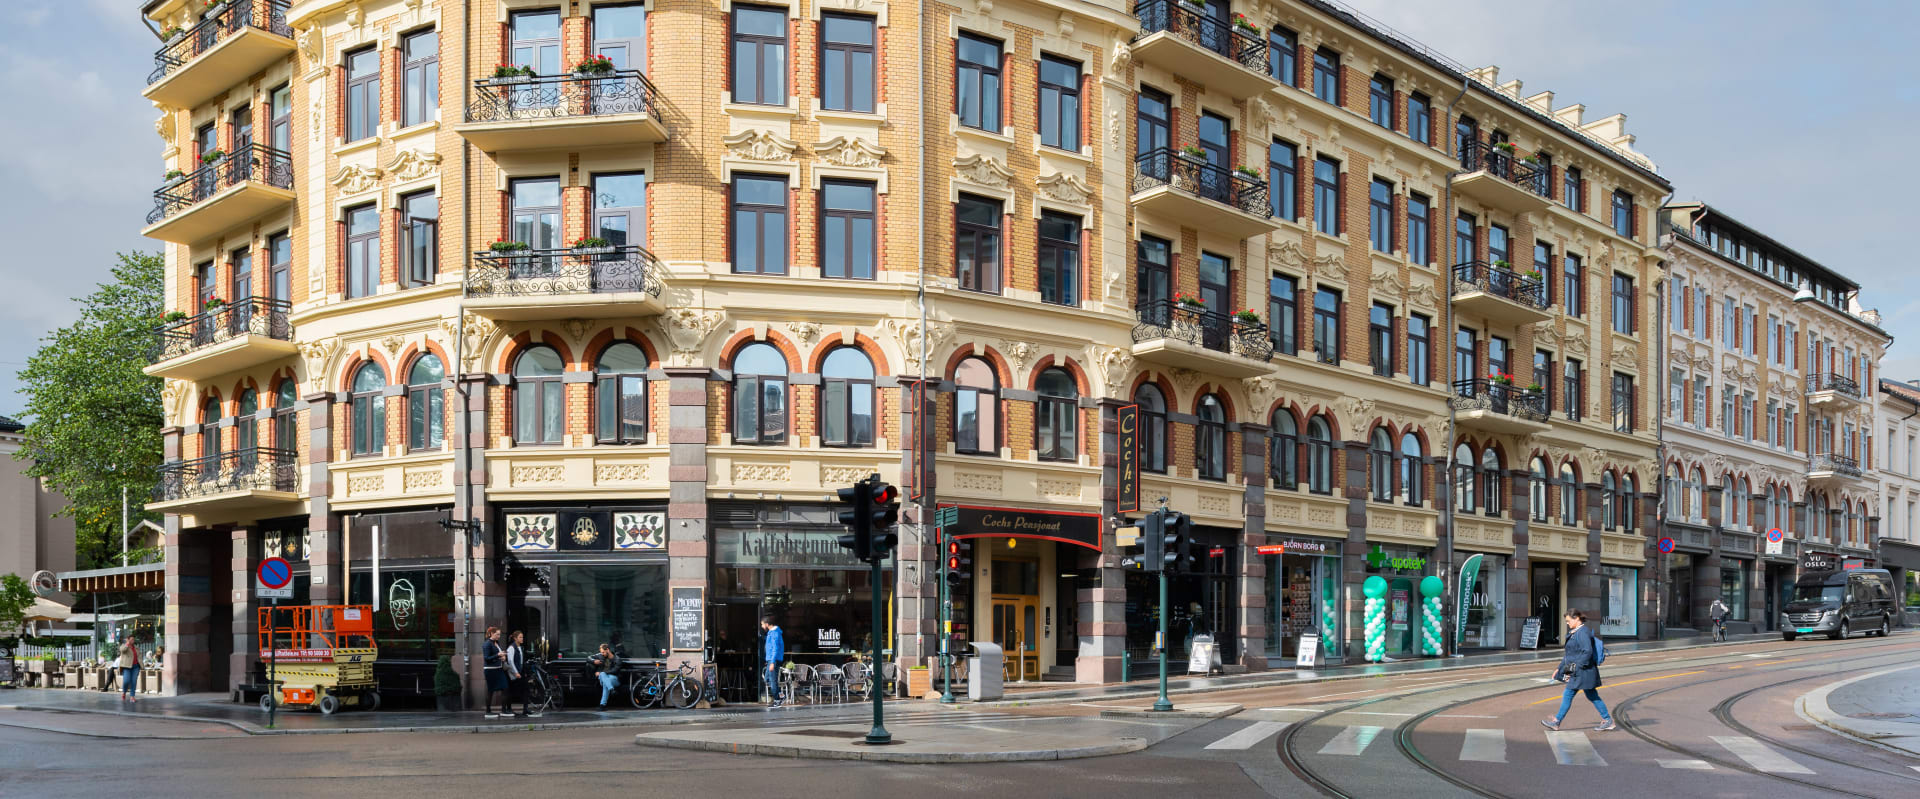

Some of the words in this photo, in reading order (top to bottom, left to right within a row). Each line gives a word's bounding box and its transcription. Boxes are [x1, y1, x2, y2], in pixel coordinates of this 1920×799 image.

[1121, 413, 1135, 494] Cochs
[982, 514, 1011, 527] Cochs
[1014, 516, 1061, 532] Pensjonat
[818, 628, 841, 640] Kaffe
